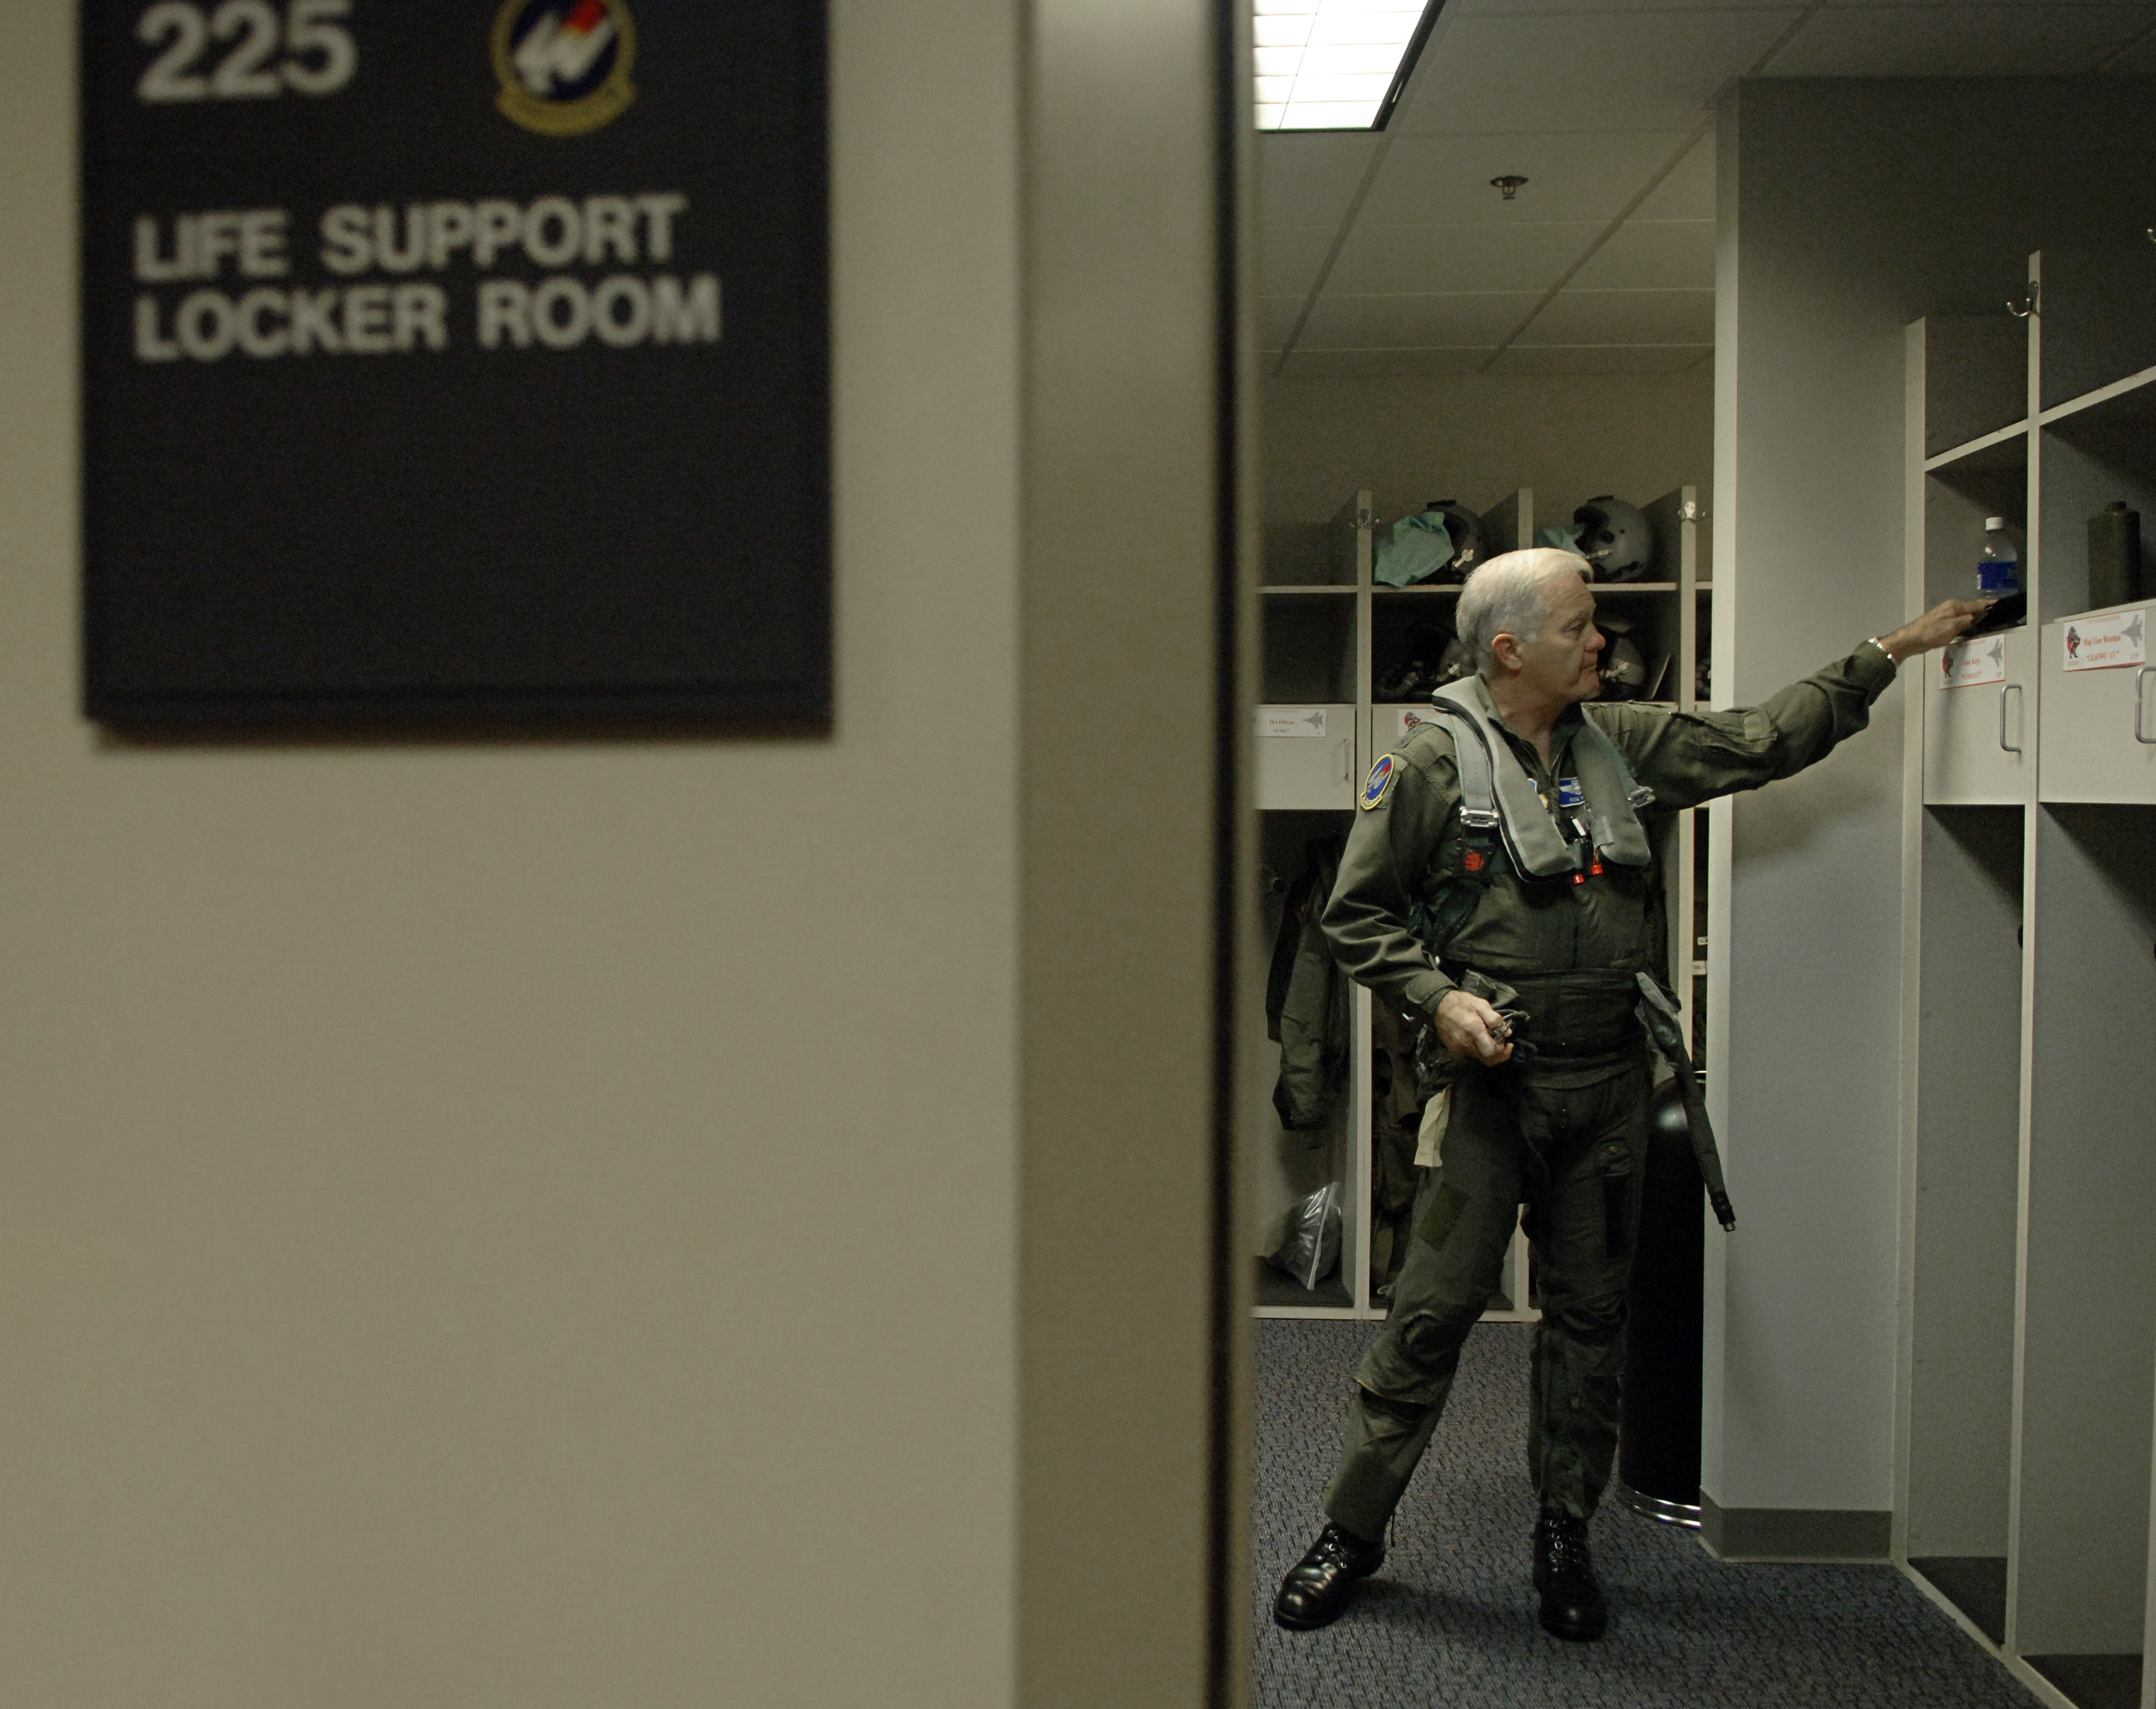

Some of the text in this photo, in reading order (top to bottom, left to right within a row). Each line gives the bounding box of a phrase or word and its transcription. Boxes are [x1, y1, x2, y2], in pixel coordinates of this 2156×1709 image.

[141, 0, 354, 99] 225
[136, 194, 683, 280] LIFE SUPPORT
[136, 275, 720, 359] LOCKER ROOM
